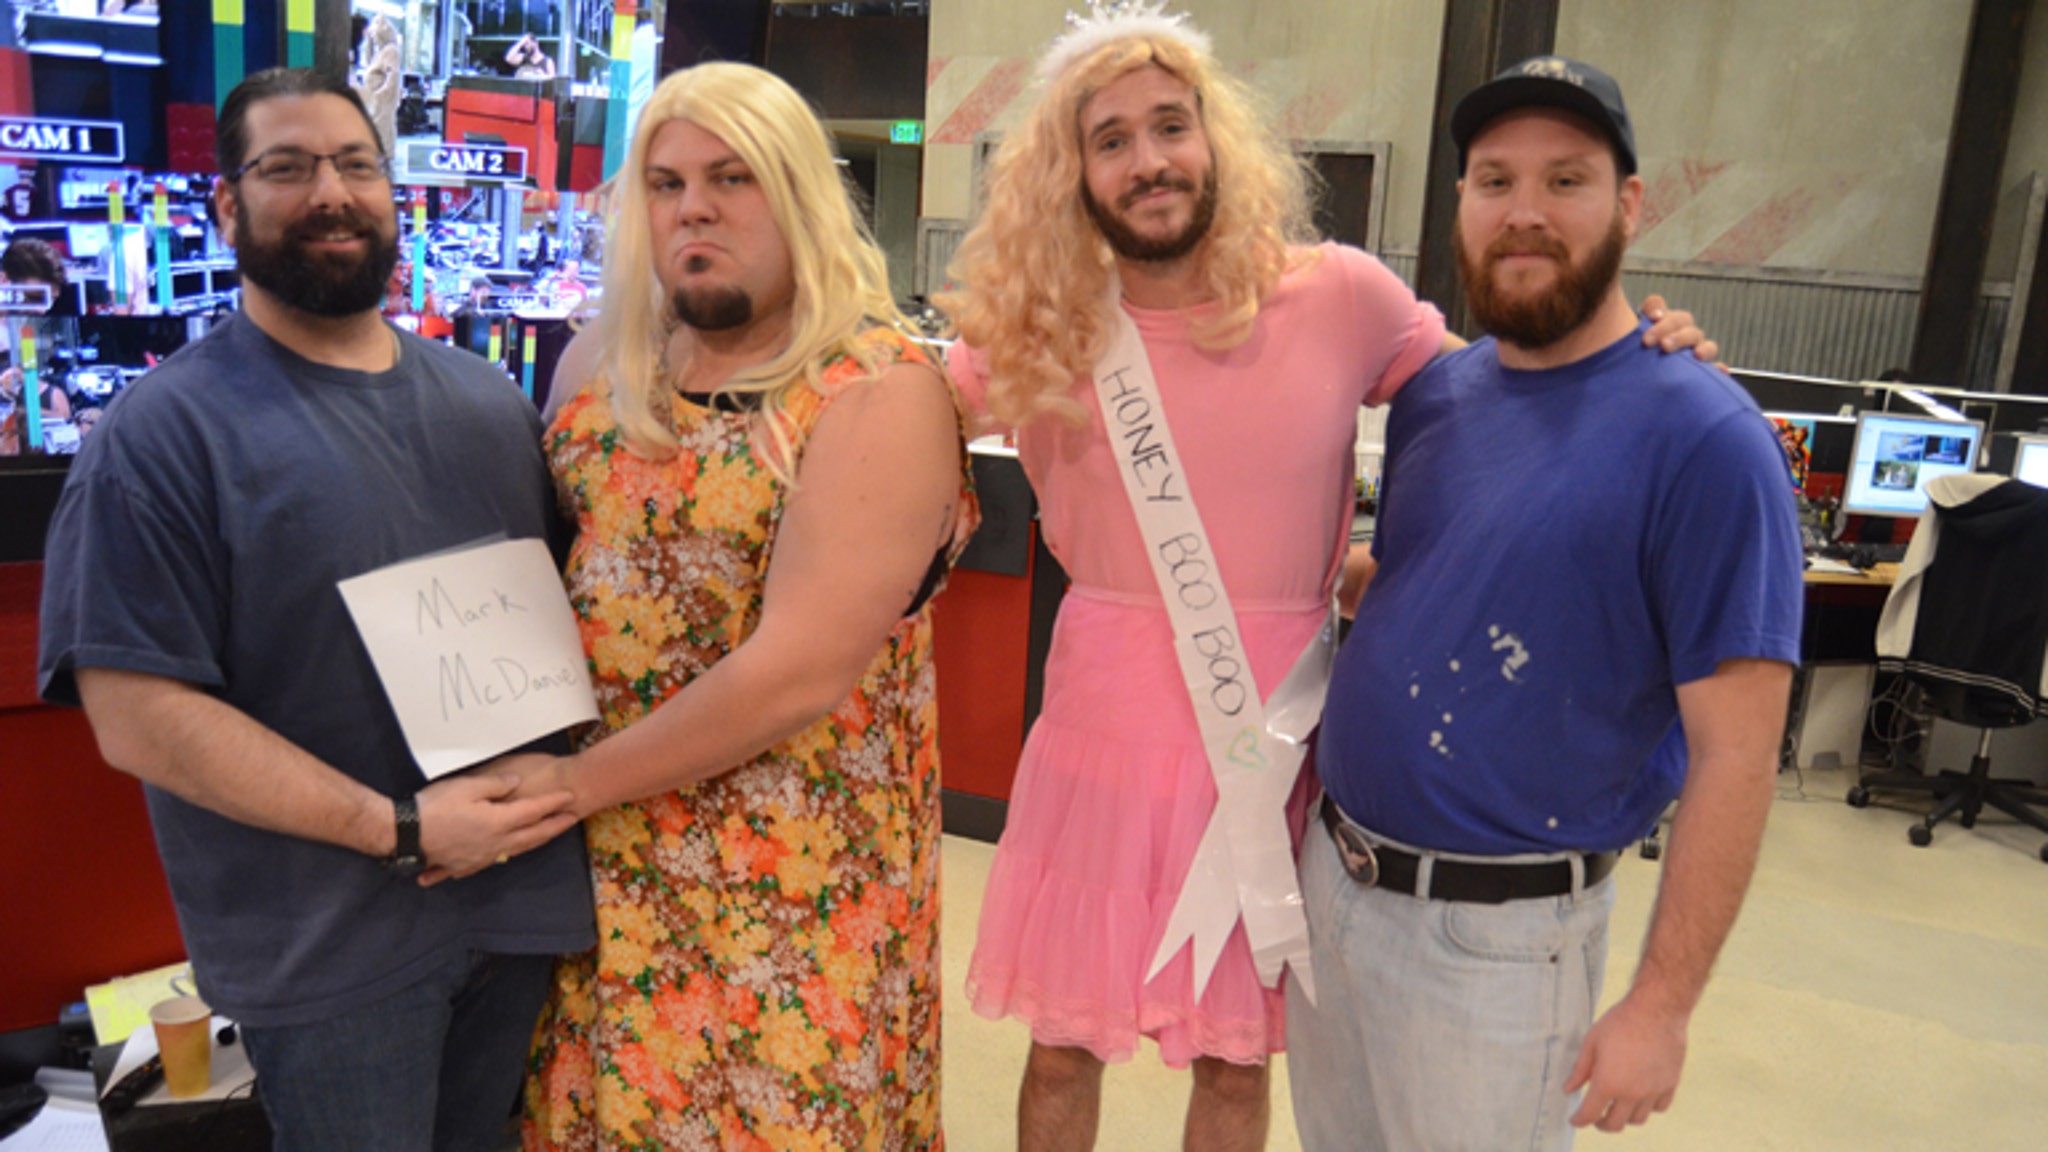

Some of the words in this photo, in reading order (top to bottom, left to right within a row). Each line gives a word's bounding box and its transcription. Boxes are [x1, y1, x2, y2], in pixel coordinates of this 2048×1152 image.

[1, 124, 71, 150] CAM
[80, 128, 91, 152] 1
[430, 149, 485, 171] CAM
[487, 154, 503, 173] 2
[1101, 365, 1183, 502] HONEY
[1158, 532, 1217, 611] BOO
[1192, 625, 1246, 717] BOO
[416, 577, 528, 635] Mark
